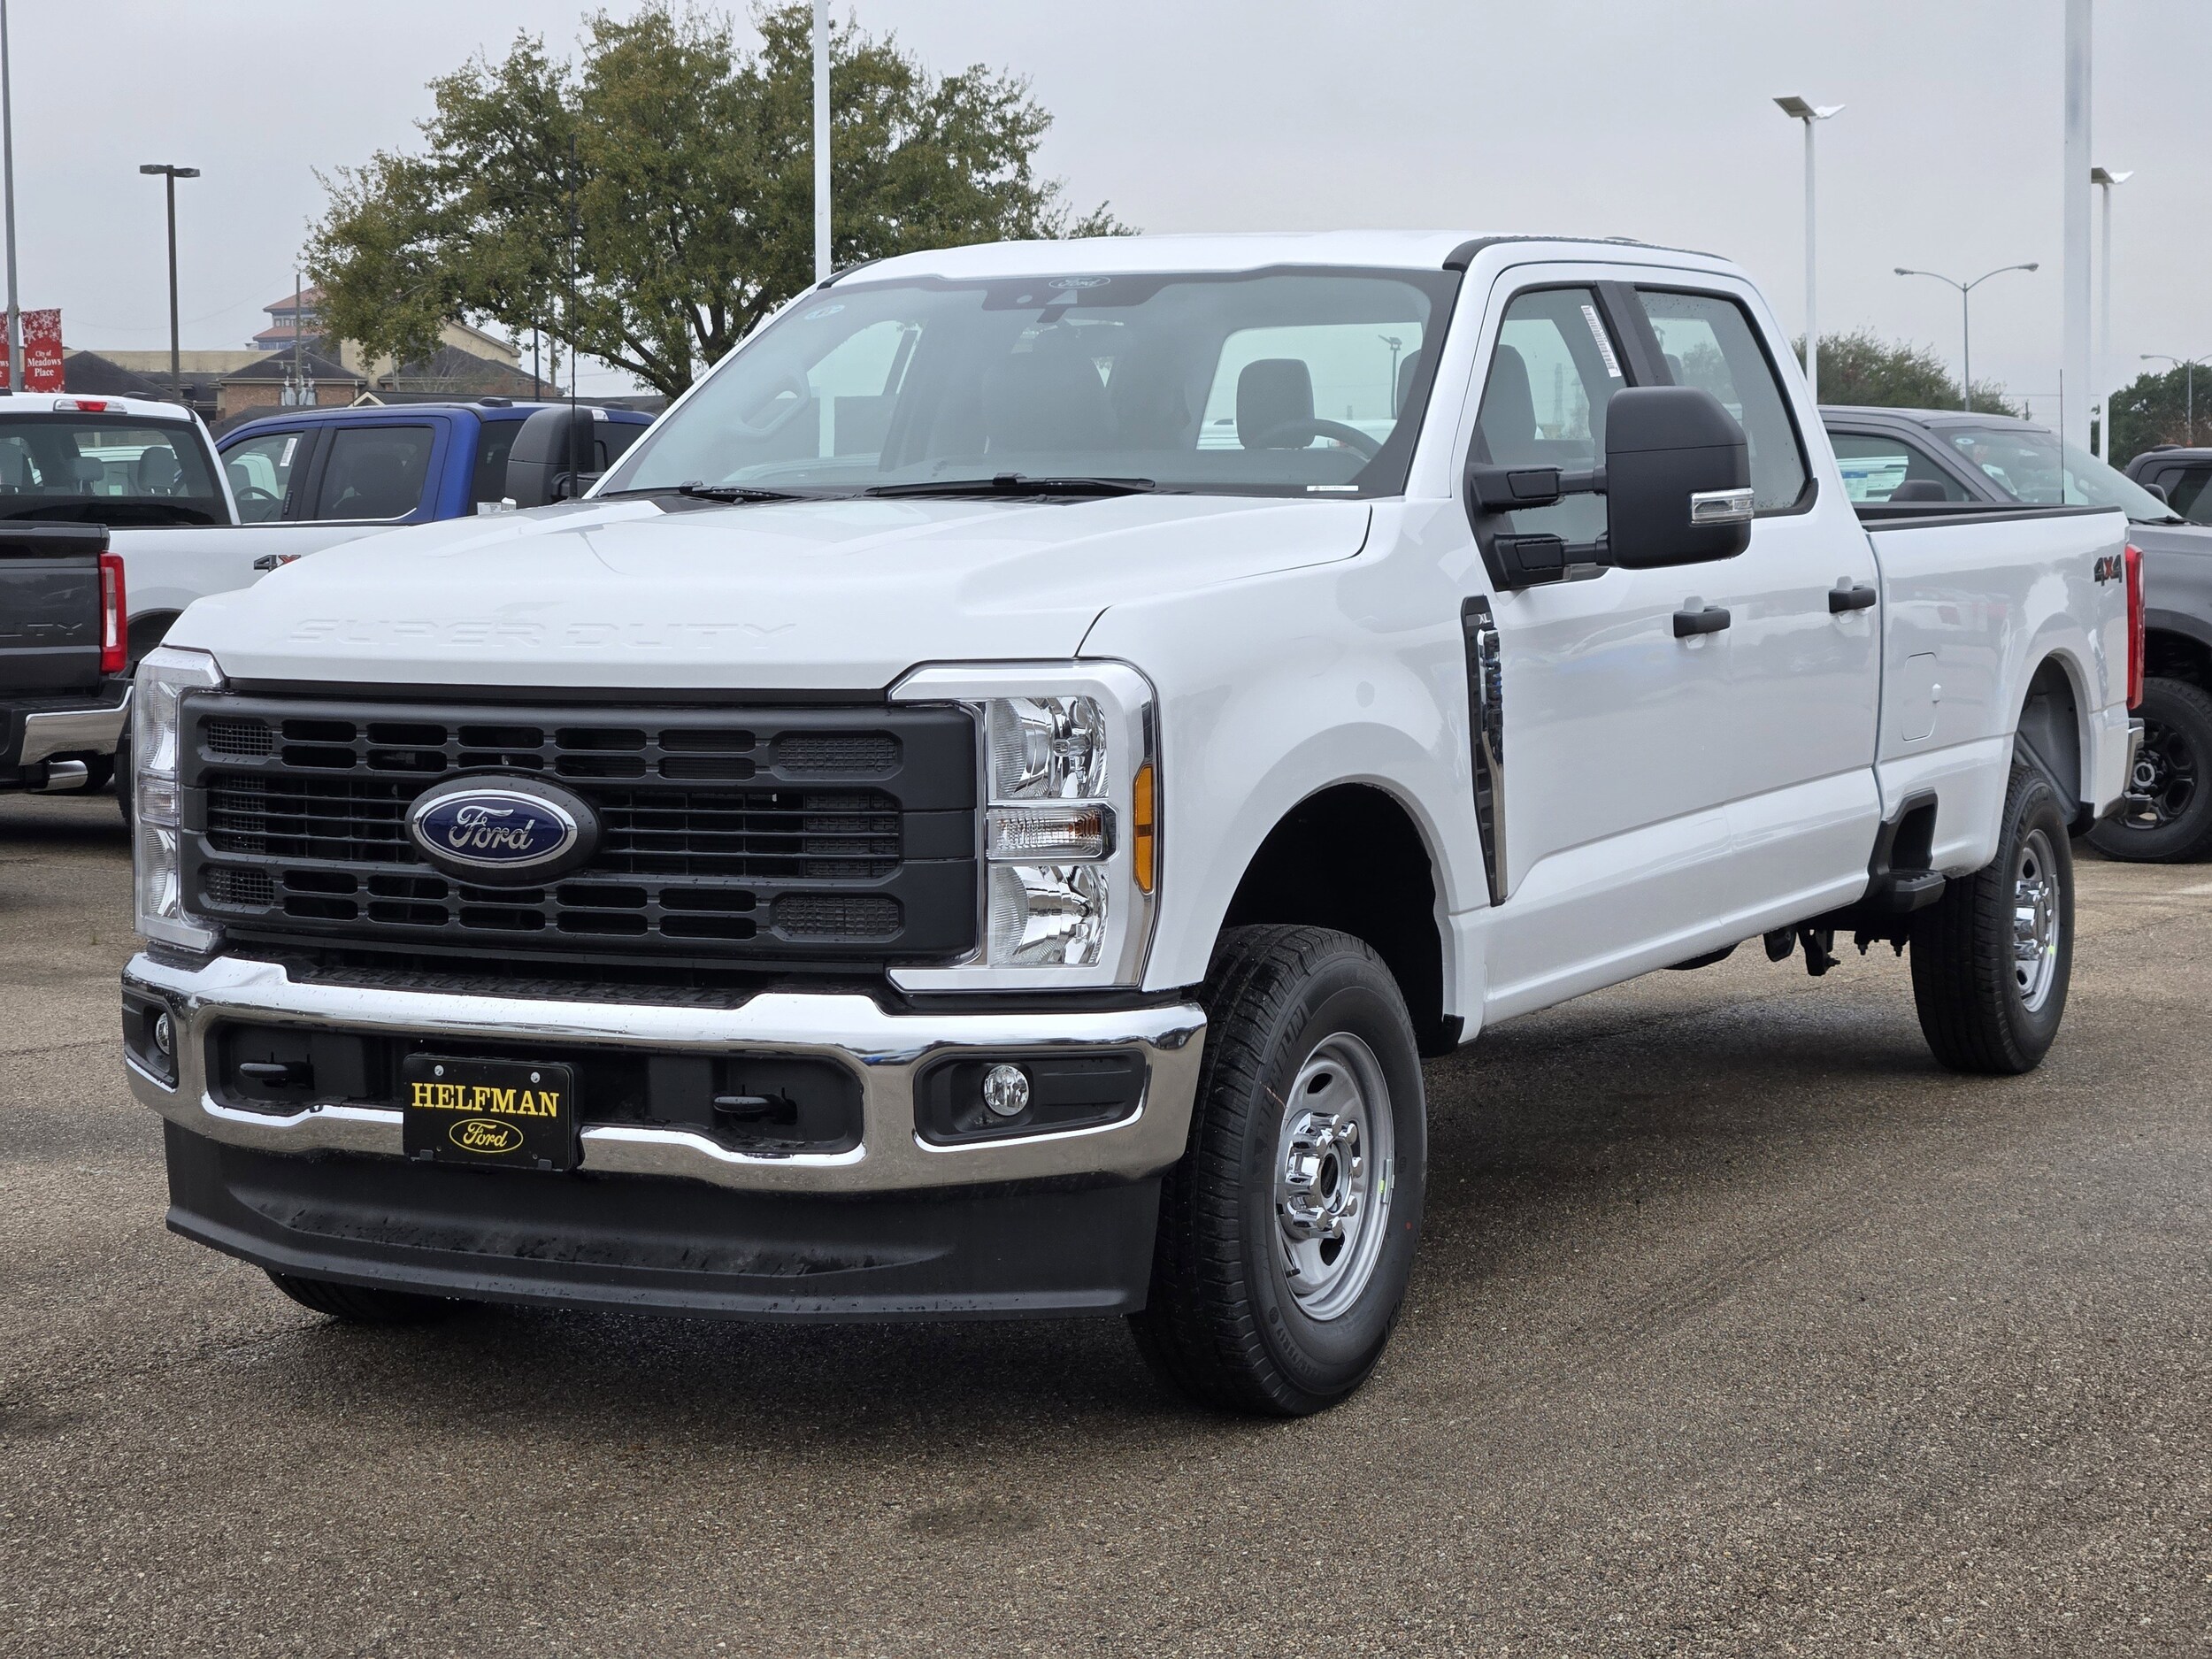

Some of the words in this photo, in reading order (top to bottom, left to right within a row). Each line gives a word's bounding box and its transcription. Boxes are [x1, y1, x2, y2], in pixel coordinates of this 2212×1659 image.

[27, 357, 62, 367] Meadows
[35, 367, 55, 377] Place
[1478, 613, 1491, 625] XL
[287, 618, 546, 648] SUPER
[561, 622, 797, 649] DUTY
[448, 805, 535, 850] Ford
[1256, 1004, 1307, 1141] MICHELIN
[411, 1082, 560, 1118] HELFMAN
[463, 1122, 509, 1148] Ford
